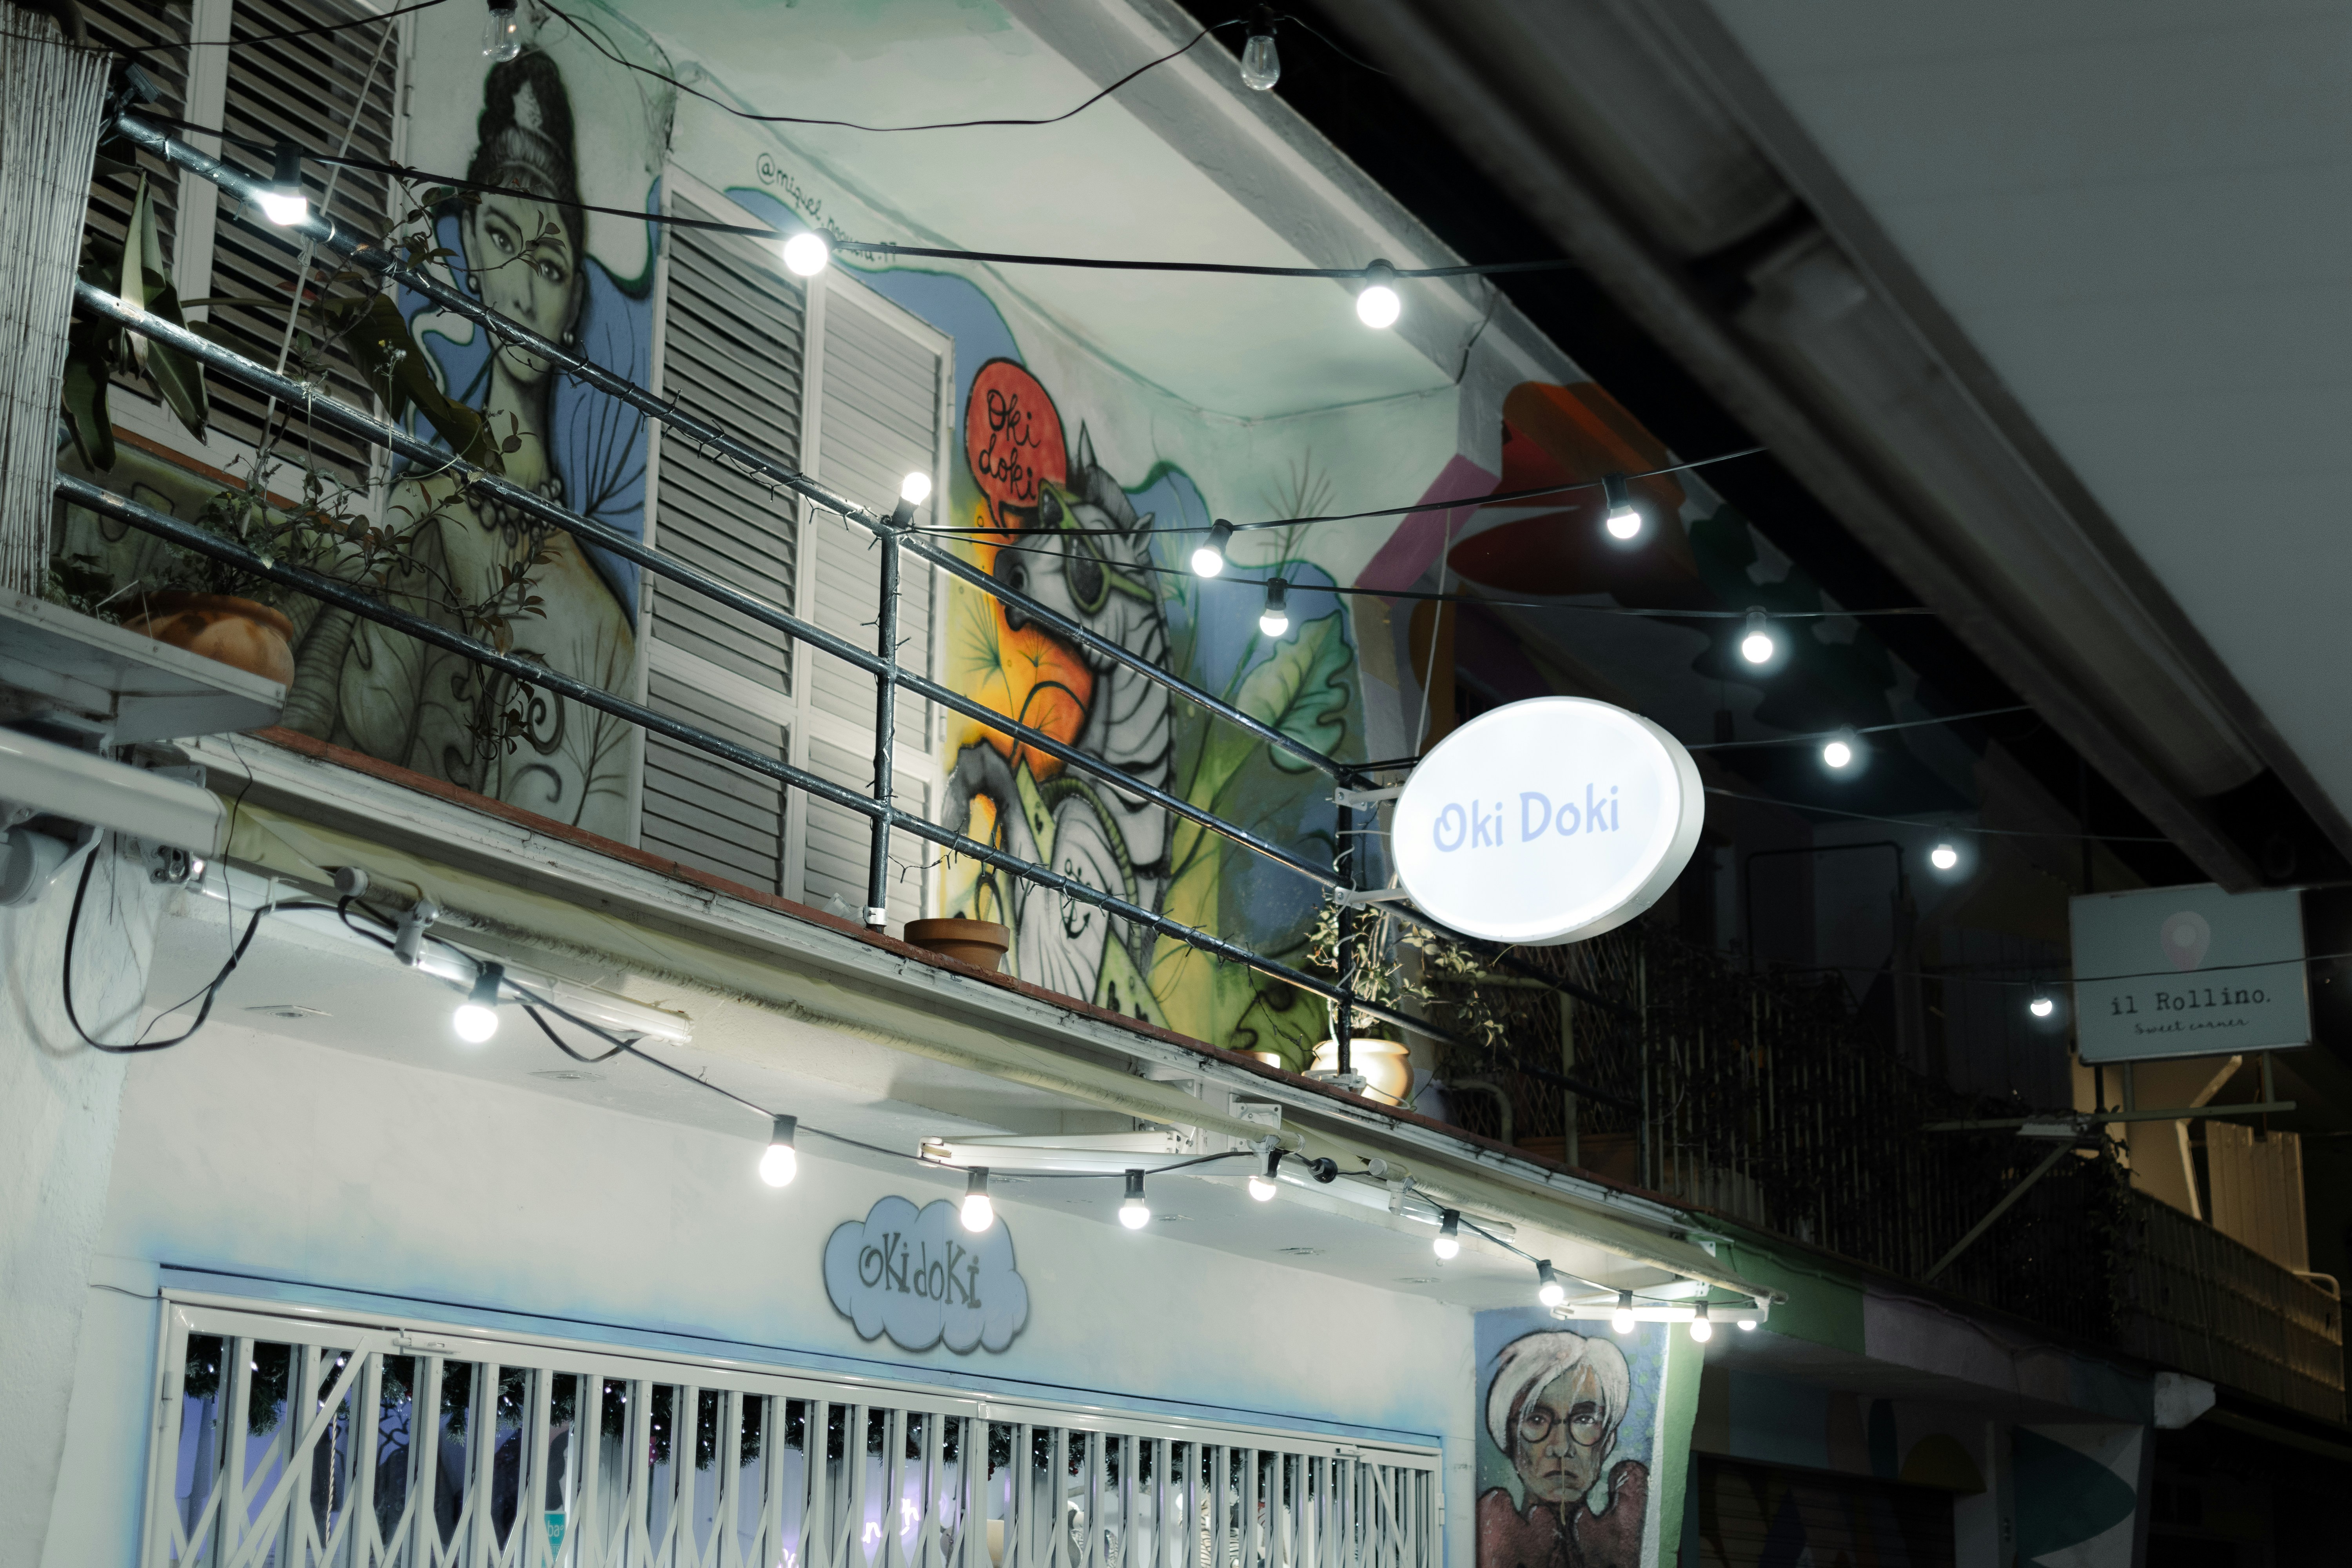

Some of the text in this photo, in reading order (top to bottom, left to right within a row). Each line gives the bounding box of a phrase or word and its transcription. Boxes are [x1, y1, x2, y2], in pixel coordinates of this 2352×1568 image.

[987, 389, 1041, 448] Oki
[978, 433, 1036, 500] doki
[1433, 783, 1620, 853] Oki Doki
[2111, 987, 2270, 1015] il Rollino.
[2134, 1020, 2186, 1035] Sweet
